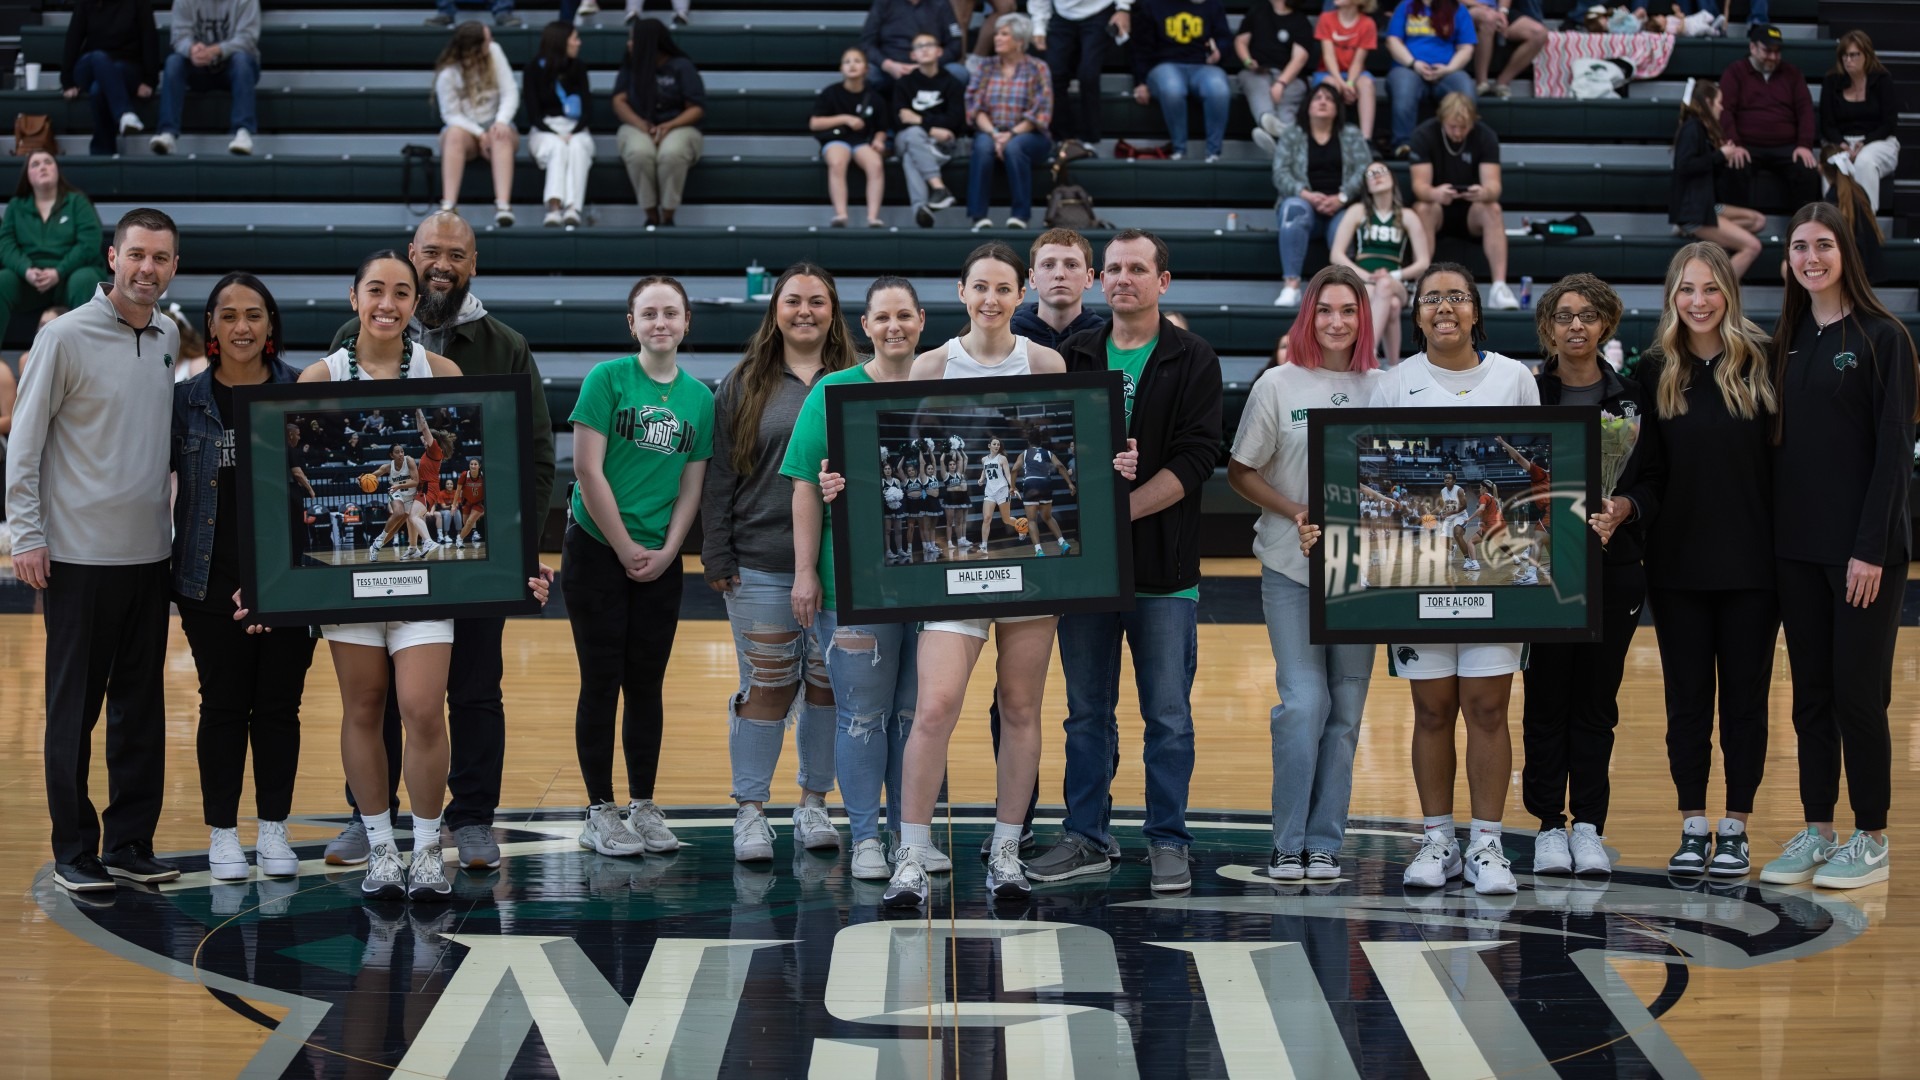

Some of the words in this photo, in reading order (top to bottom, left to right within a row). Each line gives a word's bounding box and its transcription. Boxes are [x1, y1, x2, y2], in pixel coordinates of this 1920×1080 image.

[645, 421, 671, 447] NSU
[1033, 453, 1042, 463] 4
[959, 570, 983, 582] HALIE
[984, 569, 1011, 580] JONES
[356, 578, 372, 586] TESS
[372, 577, 388, 585] TALO
[389, 576, 423, 584] TOMOKINO
[1427, 596, 1451, 606] TOR'E
[1452, 596, 1485, 606] ALFORD
